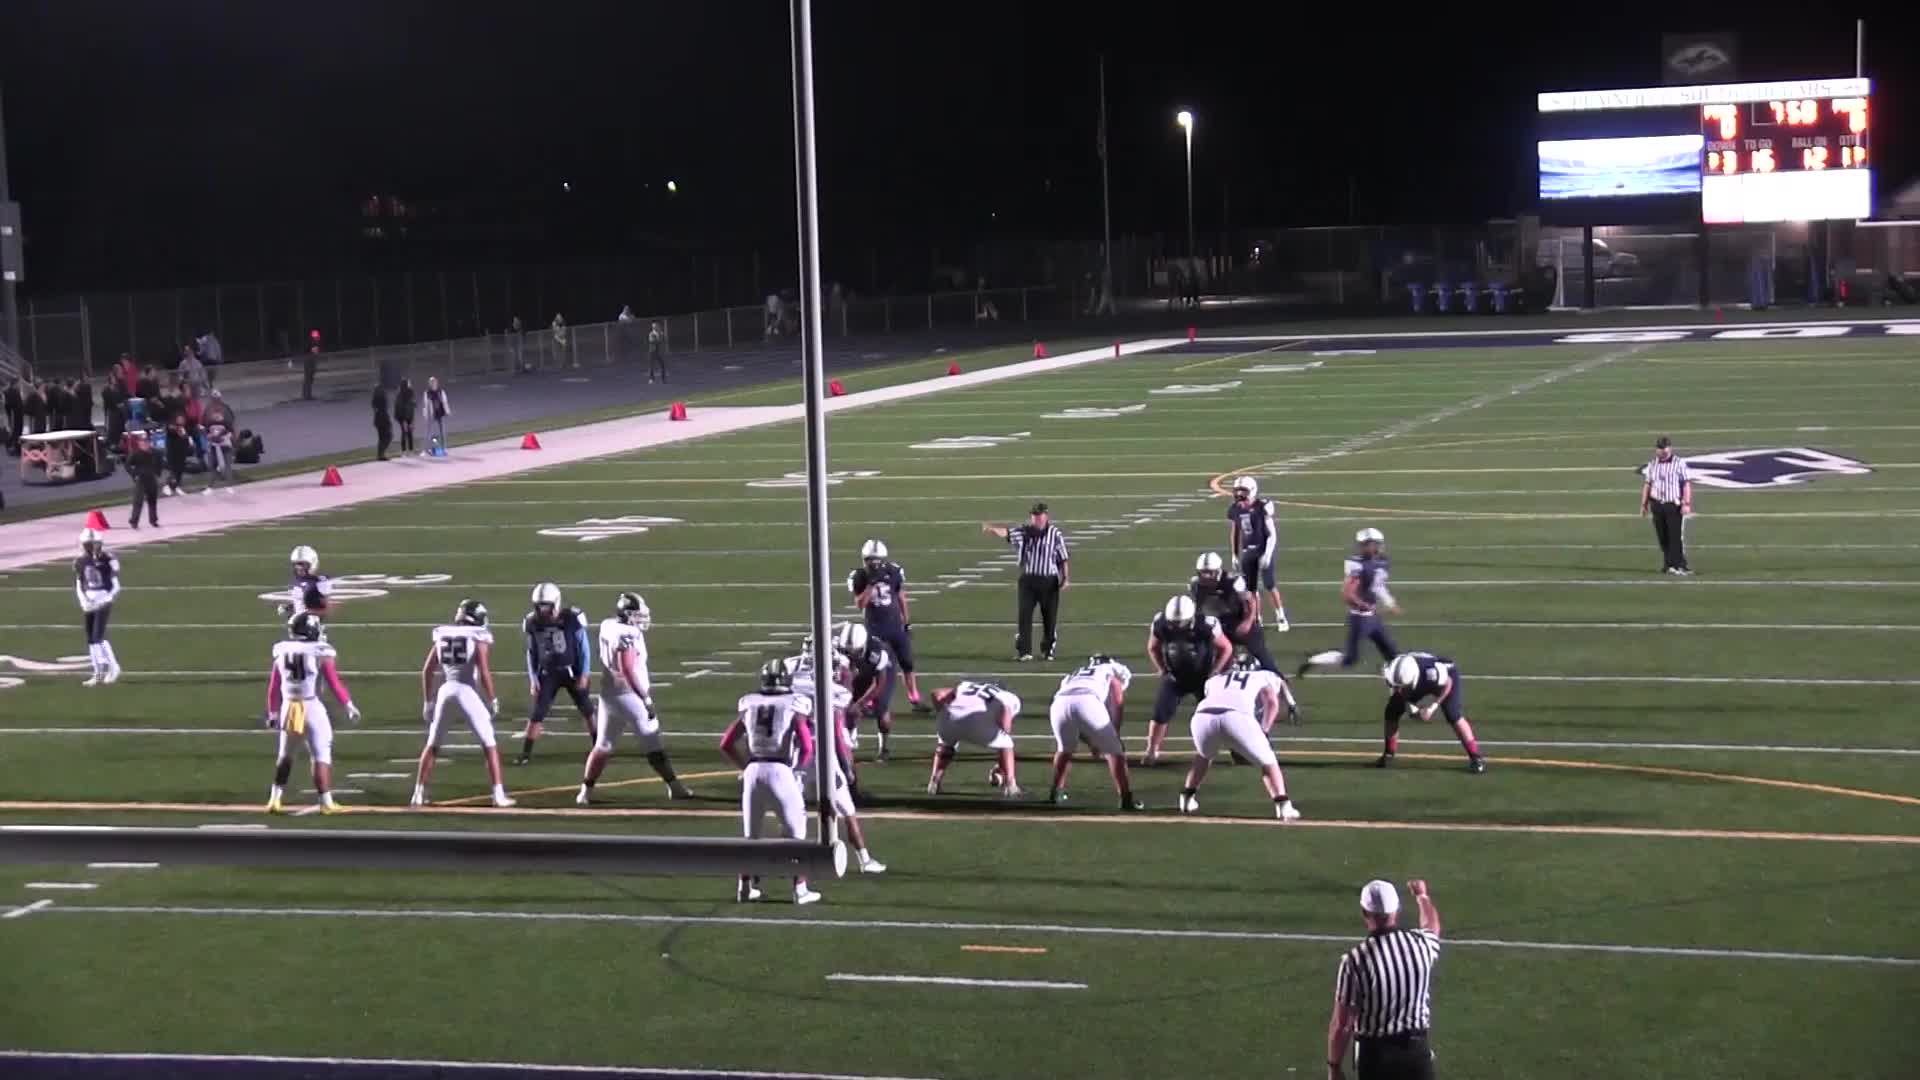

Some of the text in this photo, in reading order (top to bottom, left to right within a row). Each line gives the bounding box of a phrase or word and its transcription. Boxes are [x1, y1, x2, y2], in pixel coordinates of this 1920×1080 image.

[1744, 138, 1773, 150] TO GO
[1791, 136, 1812, 148] BALL
[440, 636, 468, 665] 22
[756, 703, 777, 738] 4
